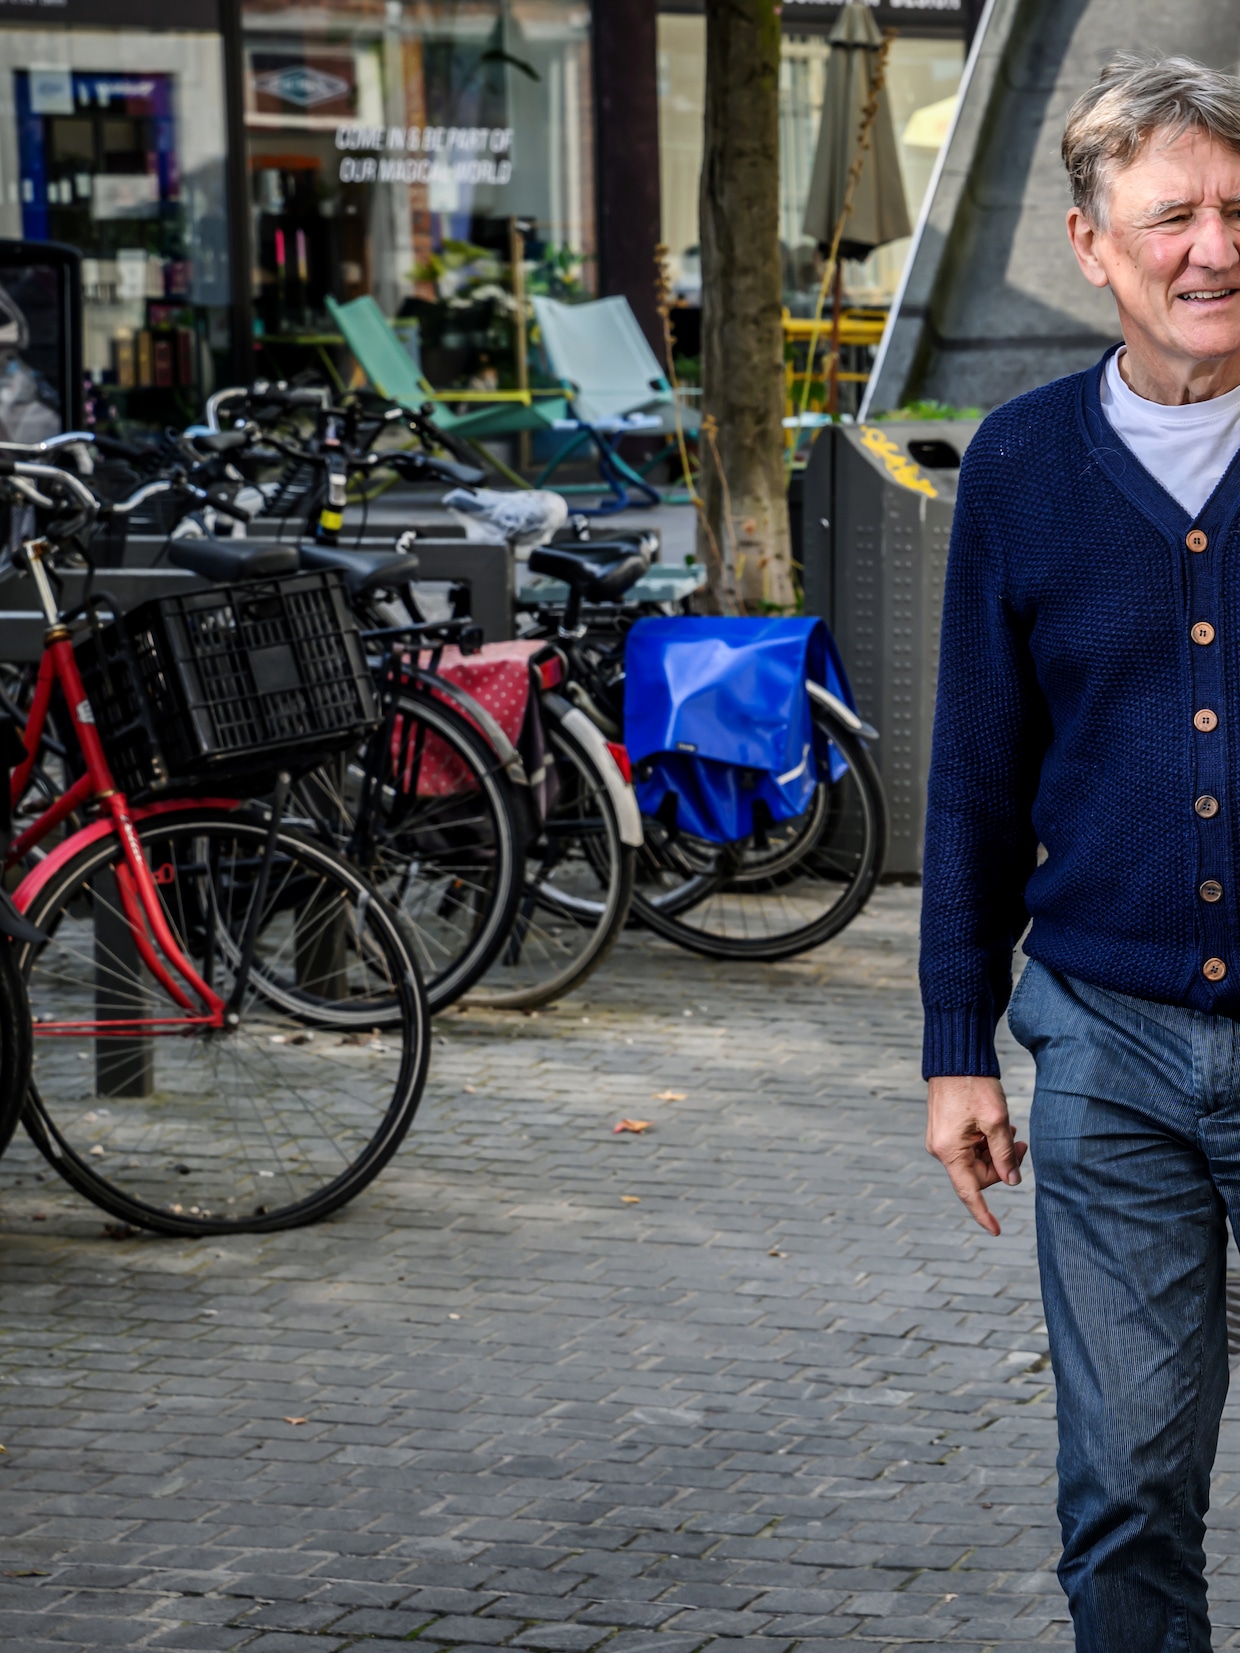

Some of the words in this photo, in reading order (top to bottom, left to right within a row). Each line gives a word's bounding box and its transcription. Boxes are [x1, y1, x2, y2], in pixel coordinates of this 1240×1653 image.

[335, 125, 385, 150] COME
[386, 126, 406, 150] IN
[422, 126, 446, 151] BE
[446, 127, 490, 152] PART
[490, 128, 515, 153] OF
[339, 157, 377, 183] OUR
[378, 158, 451, 183] MAGICAL
[455, 159, 513, 184] WORLD
